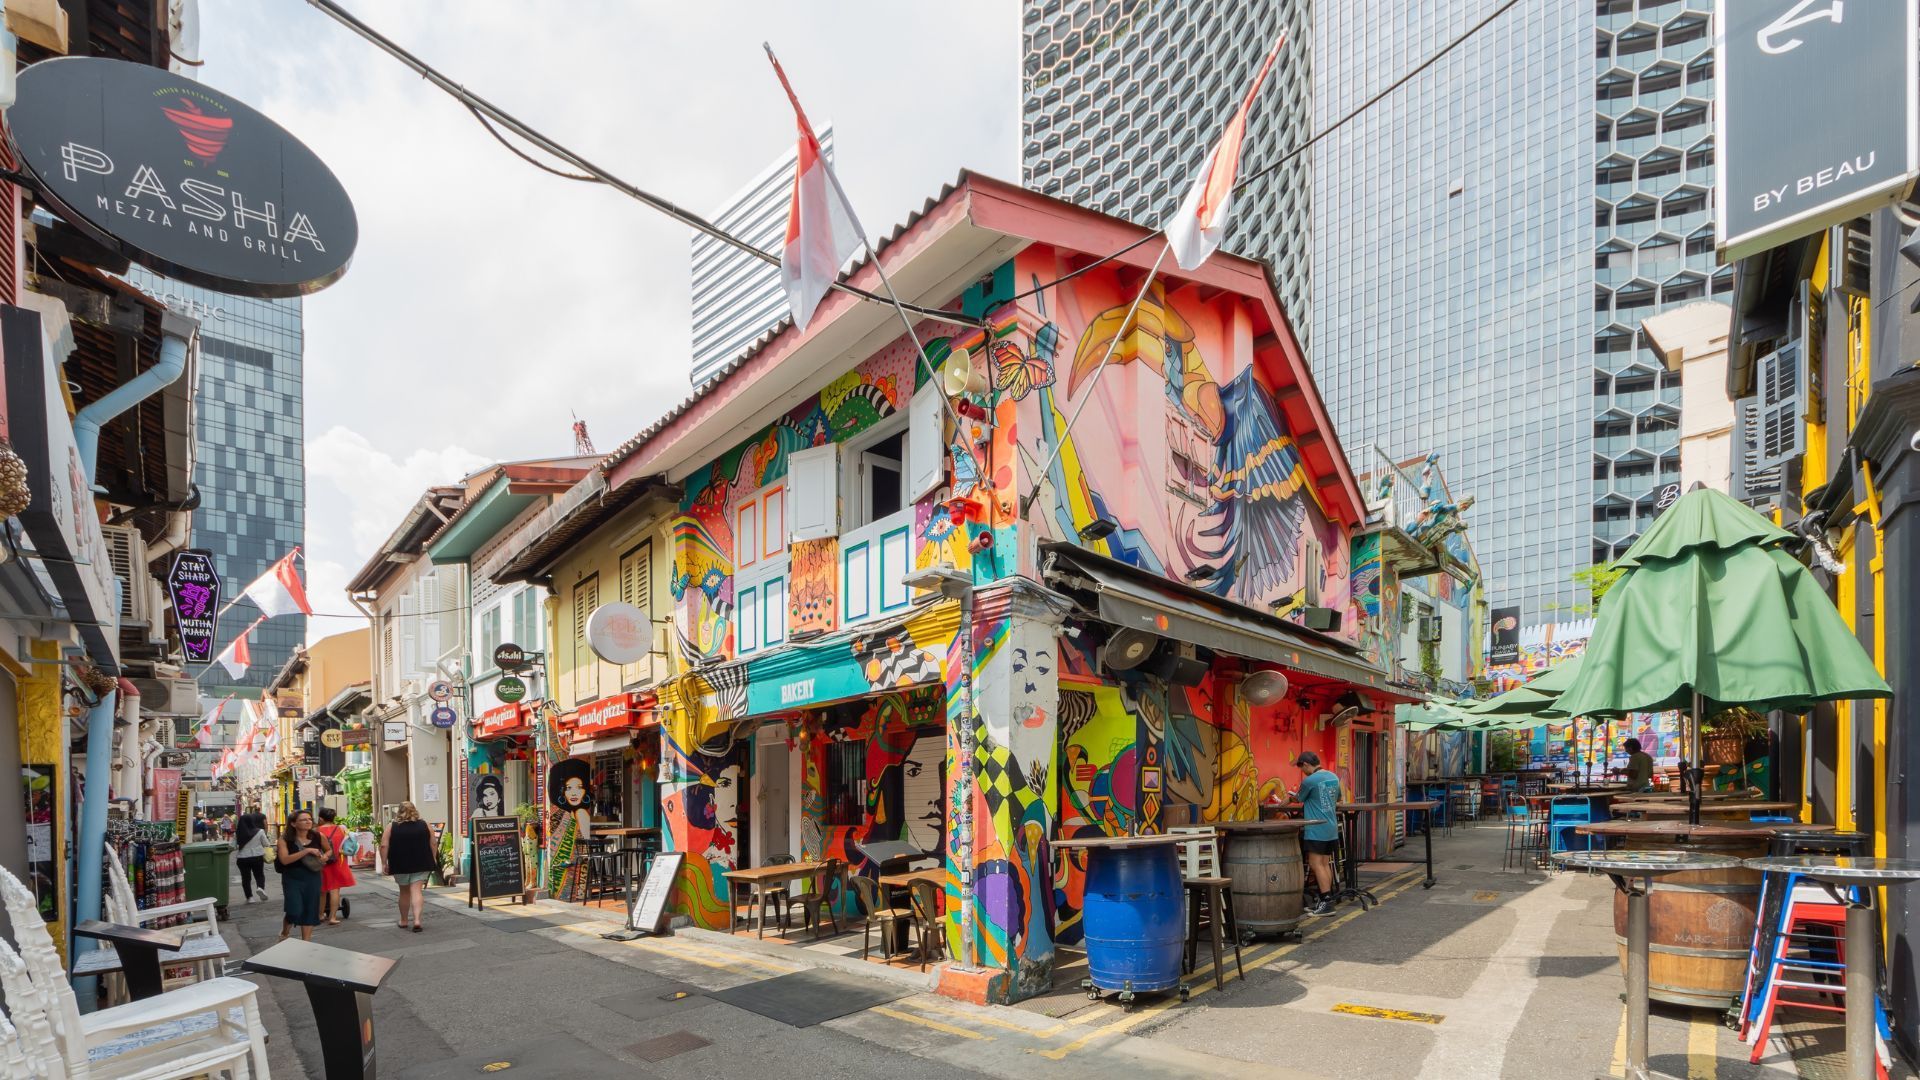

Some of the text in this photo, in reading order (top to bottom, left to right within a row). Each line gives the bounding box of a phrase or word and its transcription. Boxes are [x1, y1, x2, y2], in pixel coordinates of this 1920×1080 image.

[1753, 150, 1876, 212] BY BEAU
[61, 142, 326, 252] PASHA
[96, 194, 302, 263] MEZZA AND GRILL
[181, 561, 206, 572] STAY
[177, 570, 210, 582] SHARP
[181, 618, 213, 629] MUTHA
[496, 650, 522, 660] Asahi
[498, 684, 525, 694] Carlsberg
[781, 678, 816, 705] BAKERY
[178, 790, 189, 833] BOUTIQUE
[485, 822, 515, 830] GUINNESS
